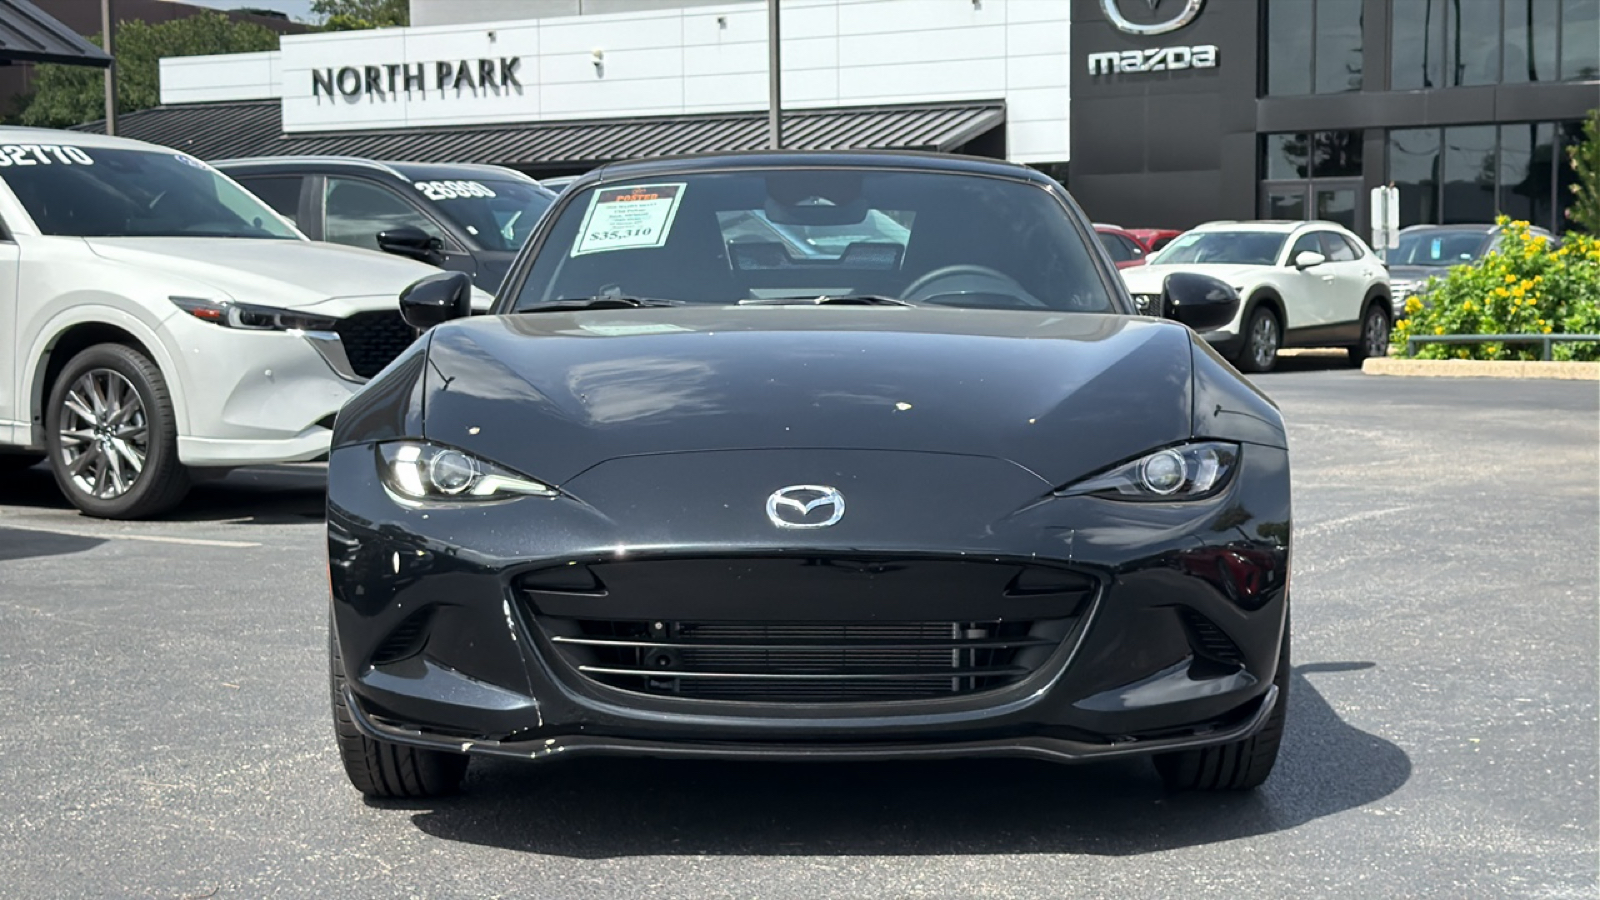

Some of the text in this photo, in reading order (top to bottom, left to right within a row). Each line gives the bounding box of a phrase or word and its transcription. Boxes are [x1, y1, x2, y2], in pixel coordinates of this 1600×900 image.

[311, 56, 522, 97] NORTH PARK
[590, 228, 652, 241] $35,310
